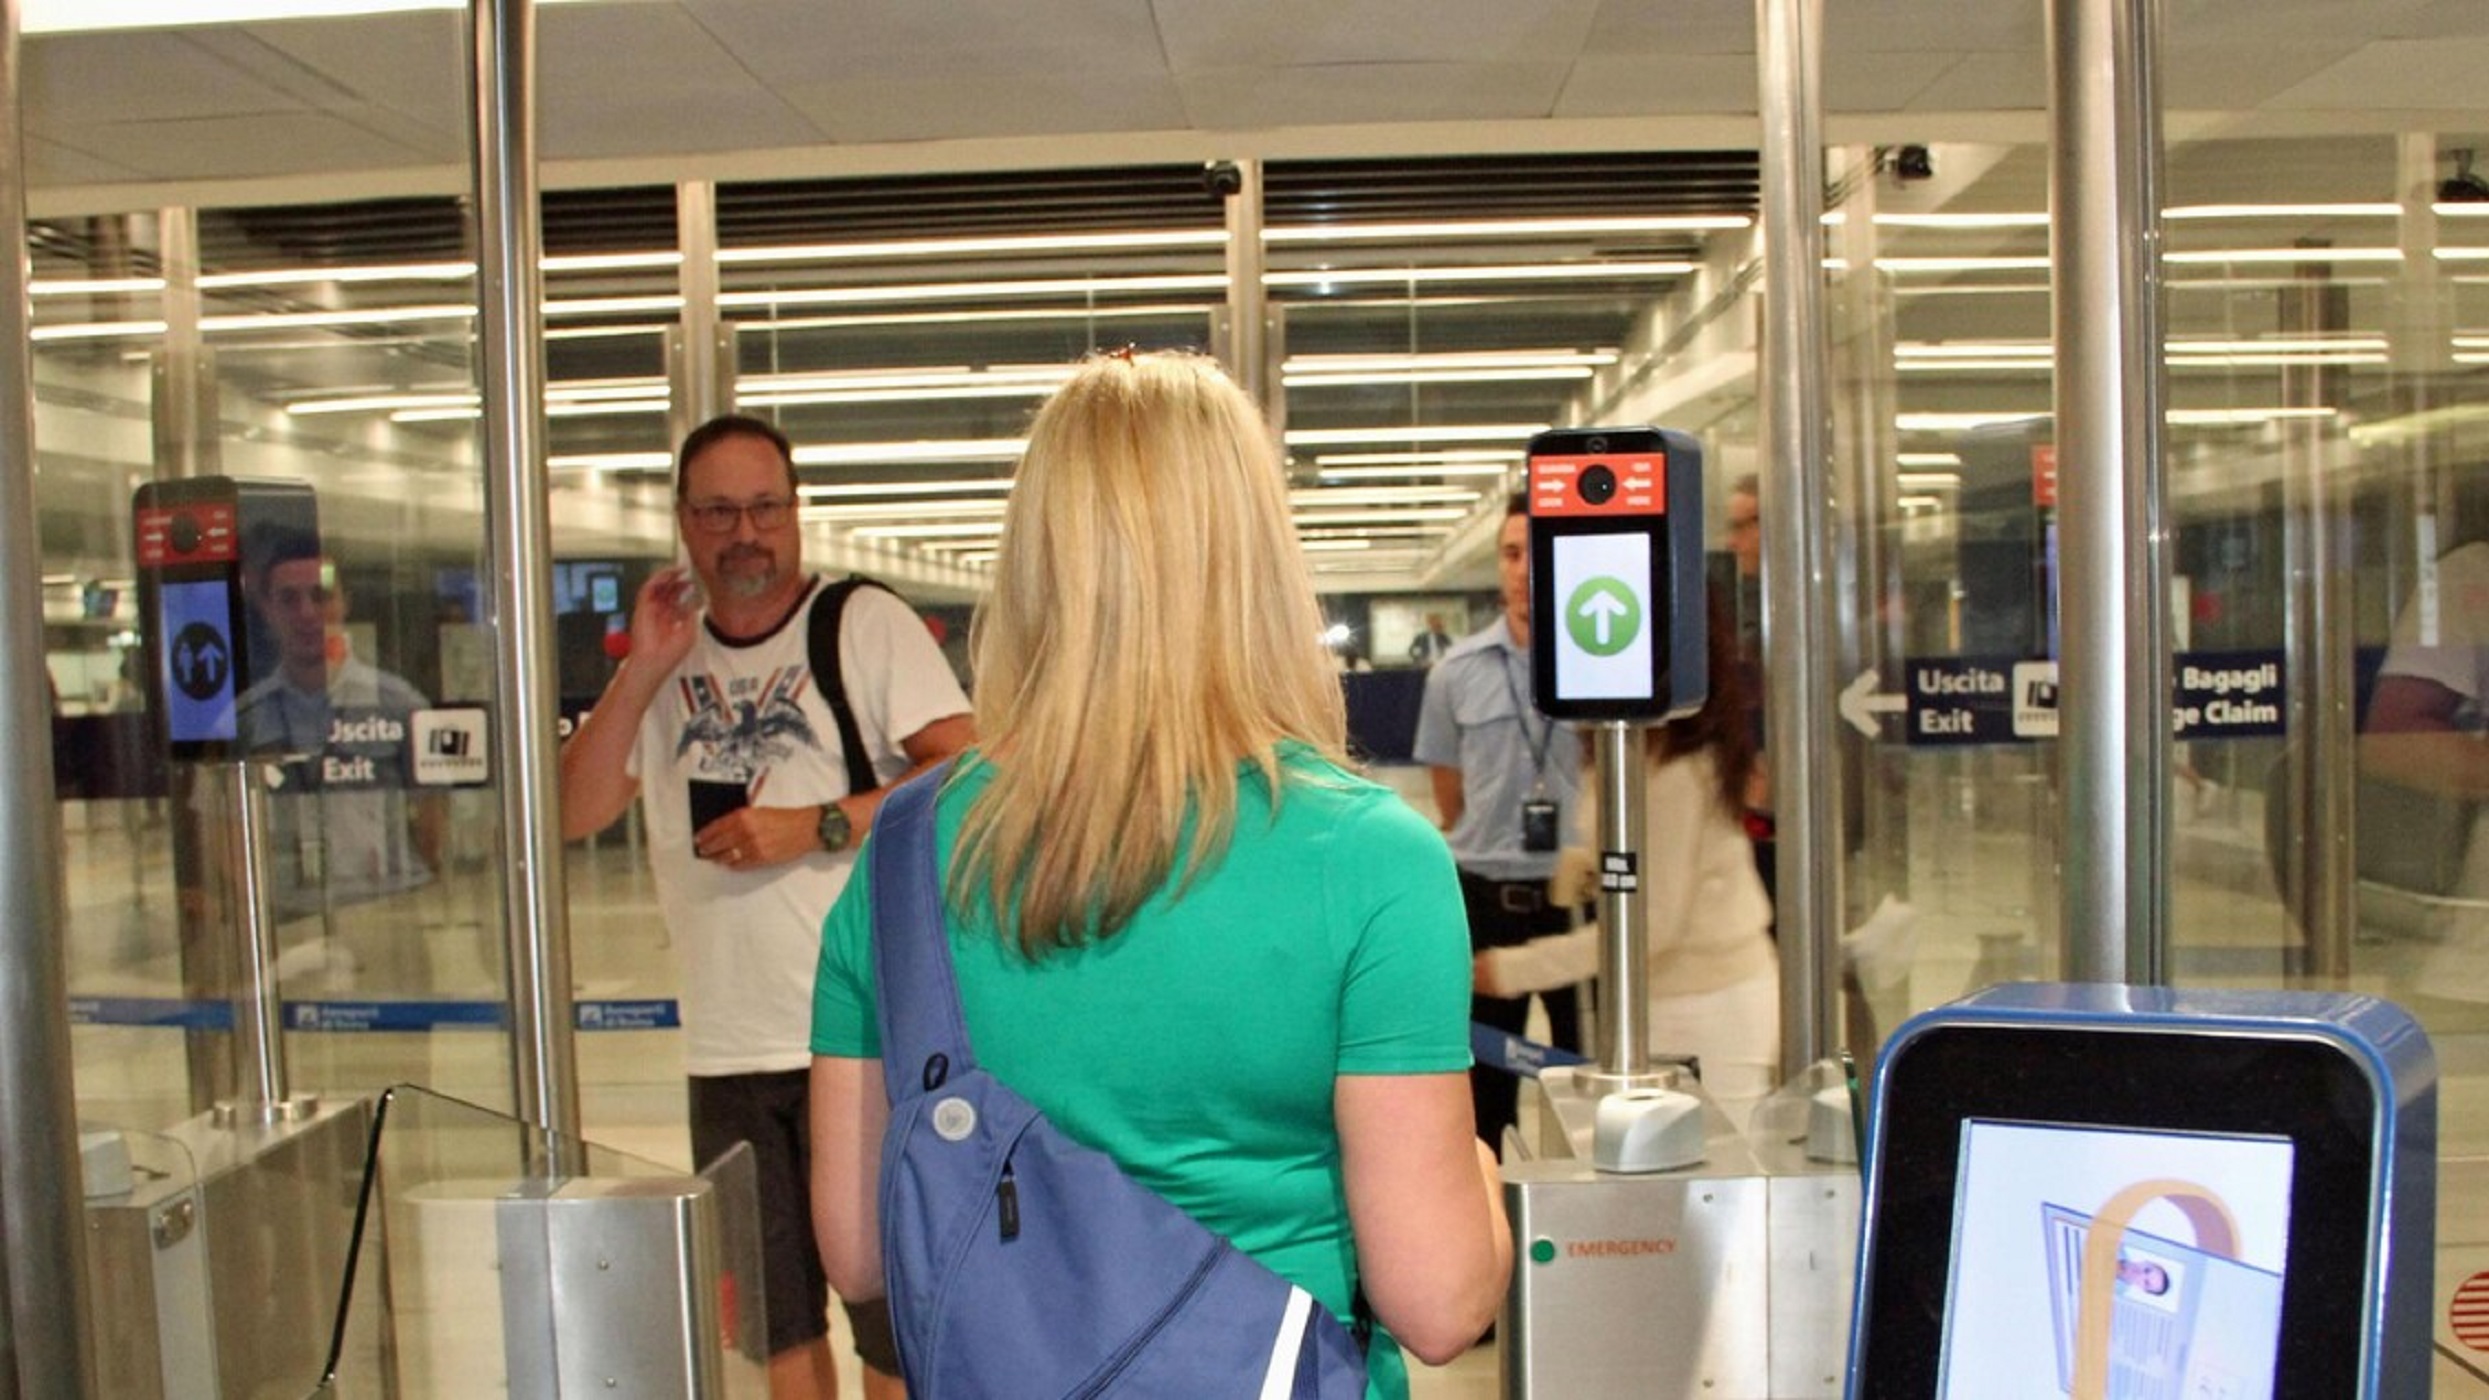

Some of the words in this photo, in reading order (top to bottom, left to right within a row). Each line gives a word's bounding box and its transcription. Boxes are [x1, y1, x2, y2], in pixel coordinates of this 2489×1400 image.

[1917, 667, 2005, 694] Uscita
[2183, 663, 2277, 694] Bagagli
[1919, 707, 1974, 733] Exit
[2205, 699, 2278, 724] Claim
[322, 755, 376, 783] Exit
[1566, 1239, 1676, 1257] EMERGENCY
